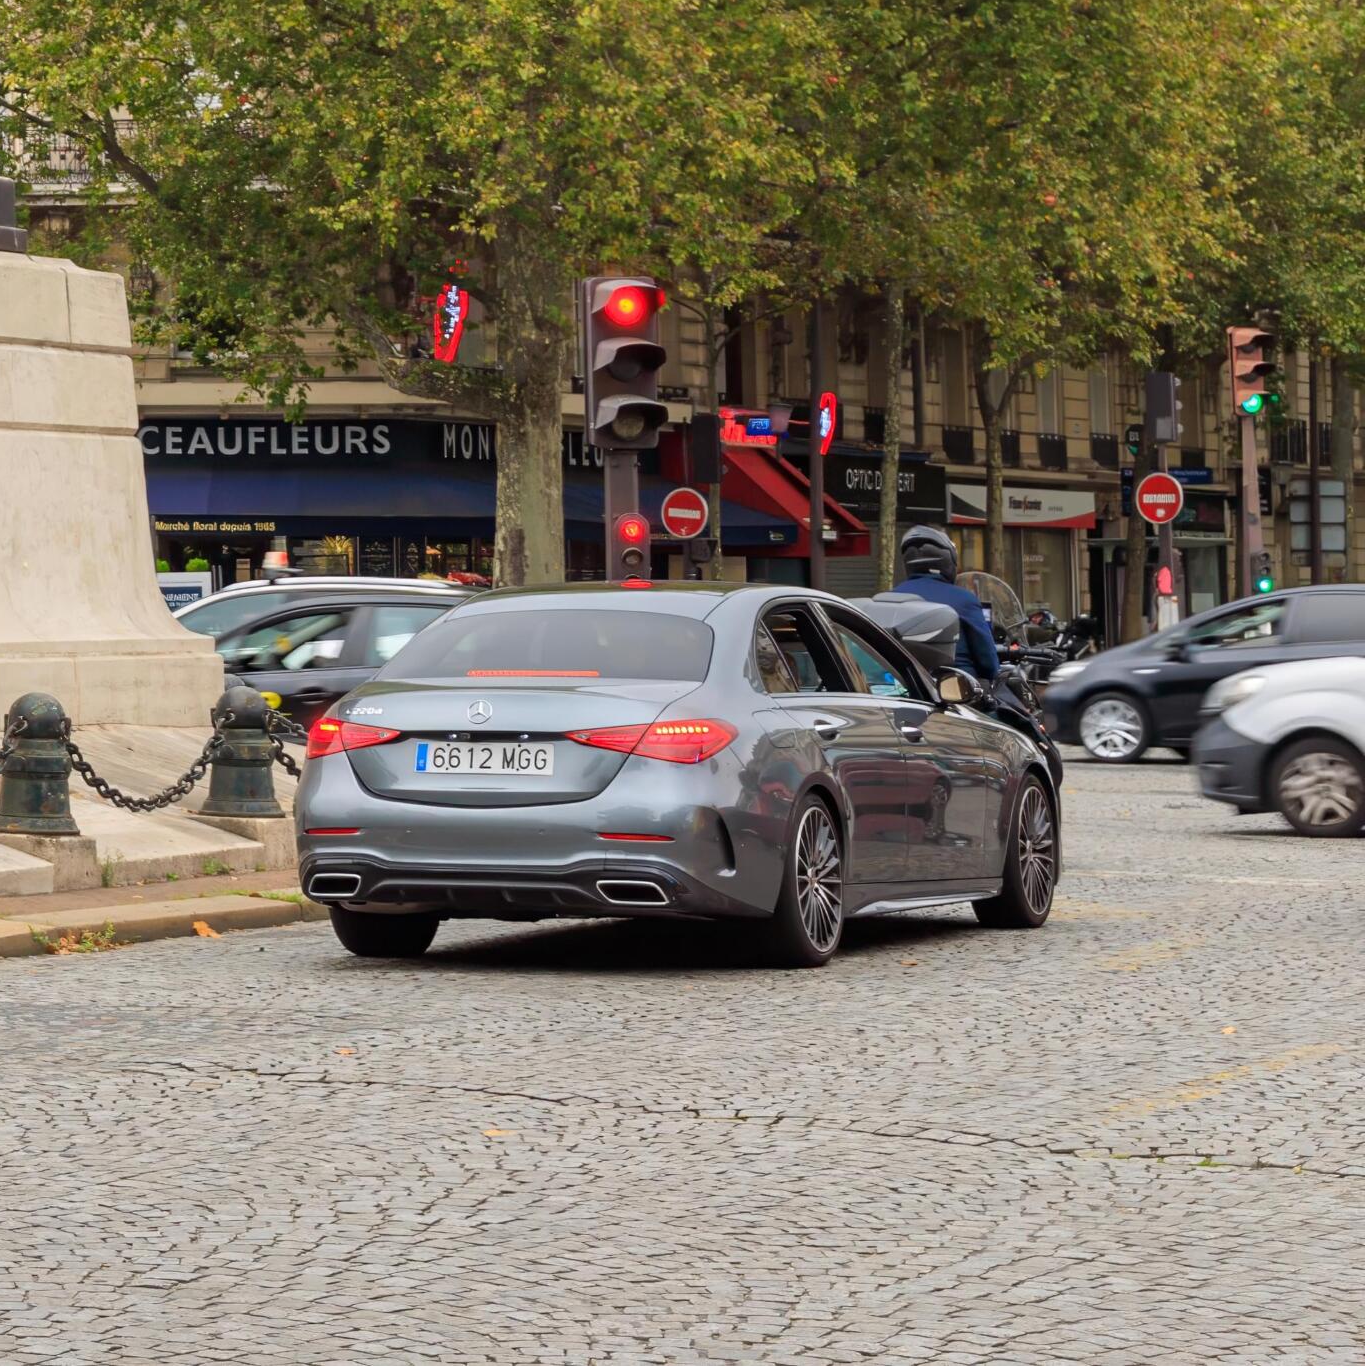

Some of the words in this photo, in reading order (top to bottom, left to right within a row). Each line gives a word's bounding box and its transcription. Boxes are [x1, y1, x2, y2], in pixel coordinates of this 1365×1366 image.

[155, 521, 190, 531] Marché
[433, 747, 493, 770] 6612
[501, 747, 547, 771] MGG
